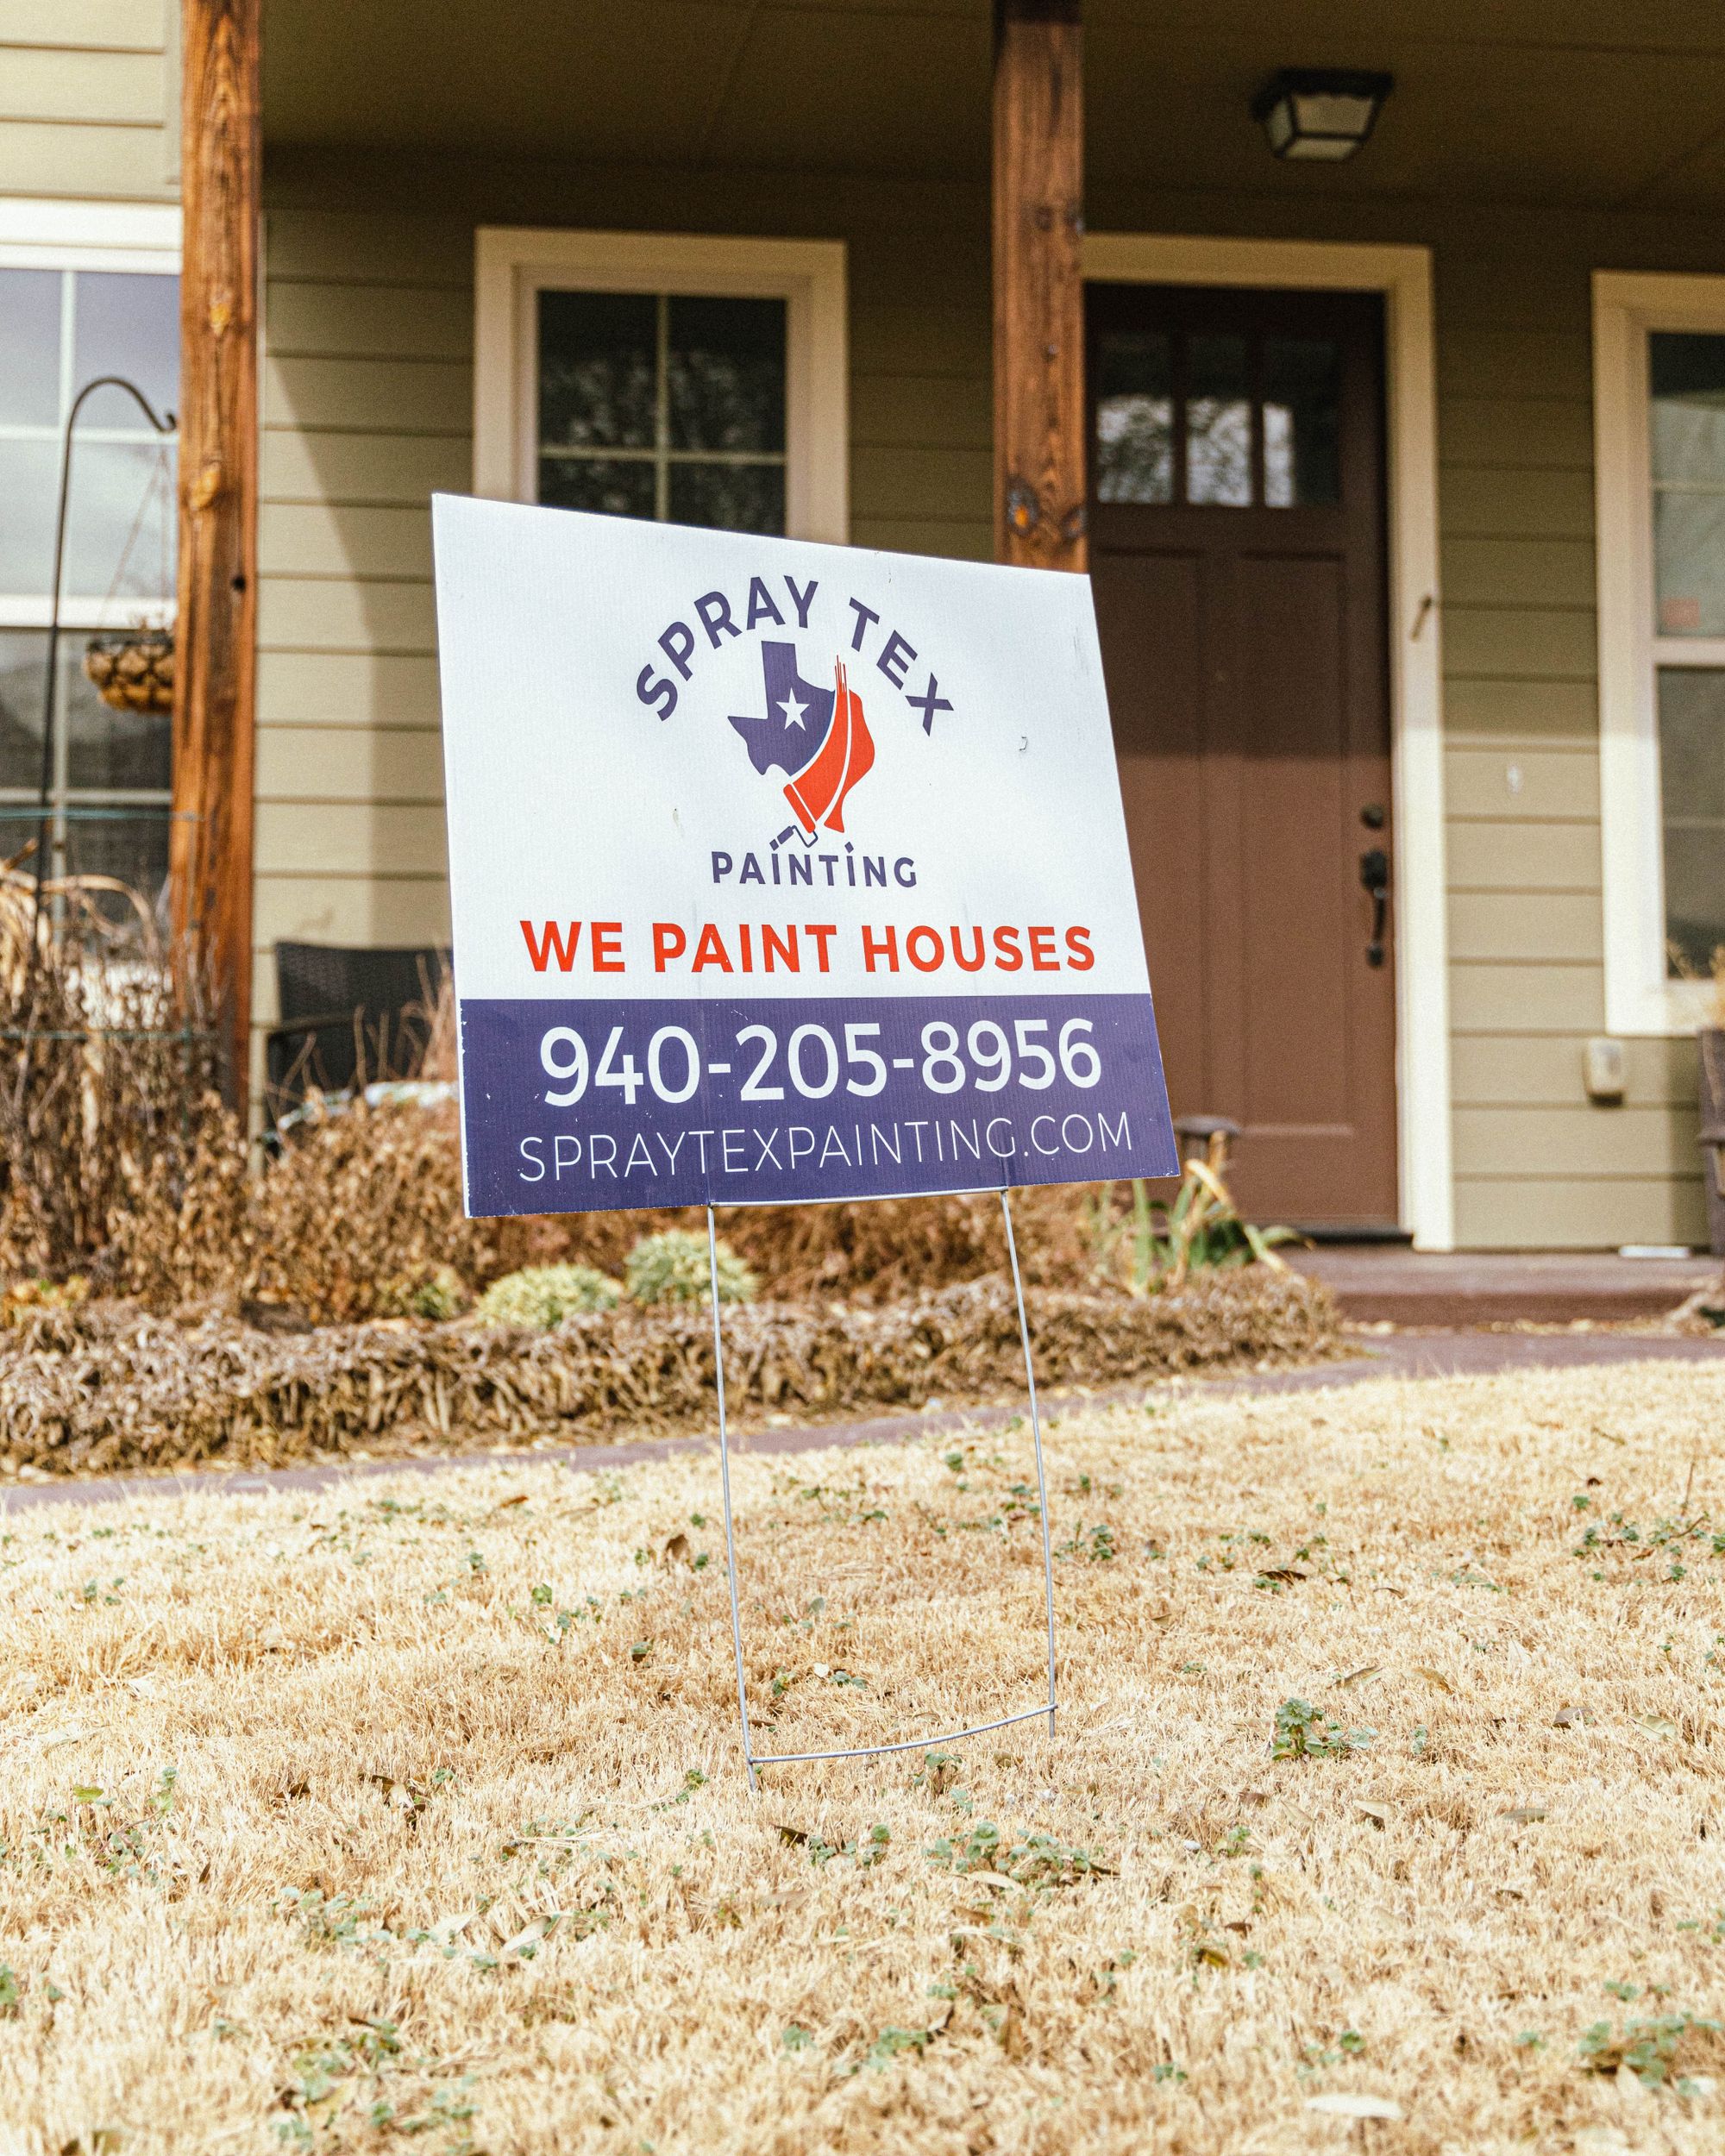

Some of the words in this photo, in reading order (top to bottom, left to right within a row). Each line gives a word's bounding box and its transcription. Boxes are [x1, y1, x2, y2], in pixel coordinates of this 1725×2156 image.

[636, 574, 819, 722] SPRAY
[847, 597, 955, 737] TEX
[519, 919, 626, 973] WE
[652, 922, 837, 973] PAINT
[861, 924, 1095, 973] HOUSES
[540, 1018, 1102, 1107] 940-205-8956
[519, 1111, 1132, 1181] SPRAYTEXPAINTING.COM
